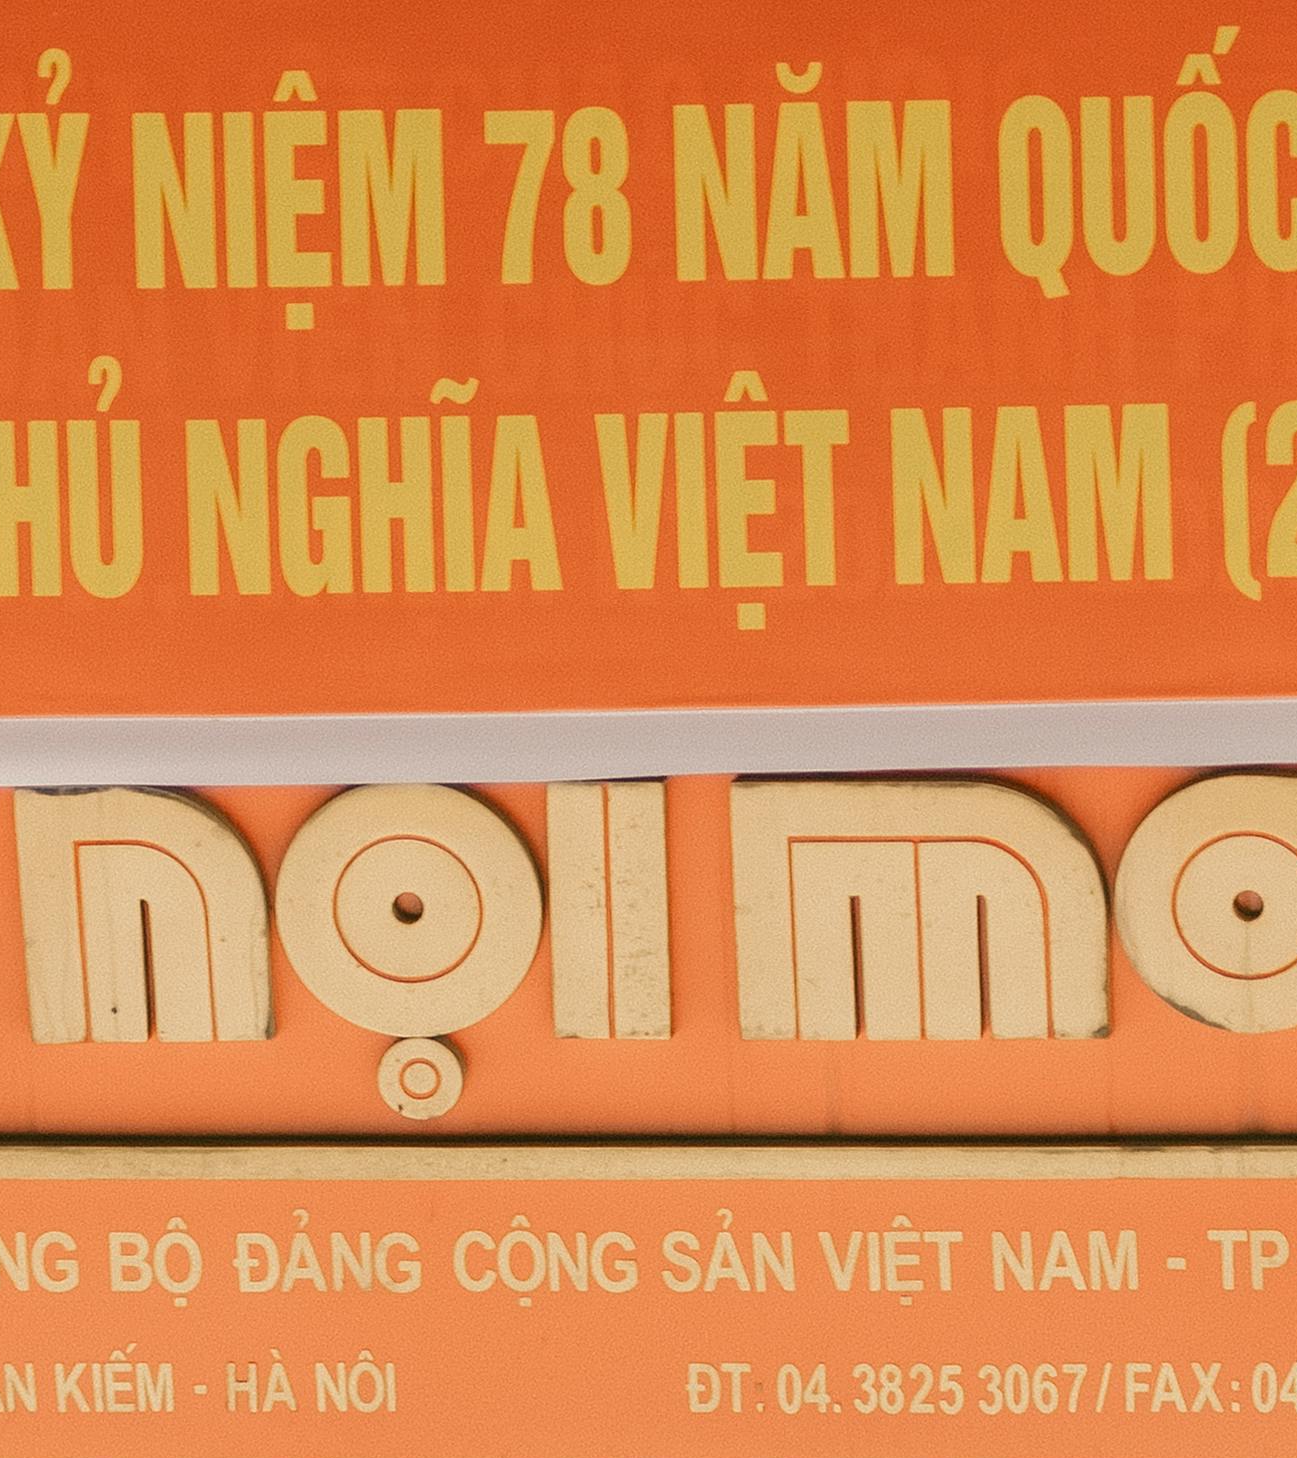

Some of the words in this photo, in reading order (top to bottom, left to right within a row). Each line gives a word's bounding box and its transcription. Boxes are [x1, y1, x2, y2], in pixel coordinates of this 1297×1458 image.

[132, 70, 446, 331] NIỆM
[484, 106, 631, 286] 78
[673, 62, 954, 282] NĂM
[185, 378, 563, 598] NGHĨA
[595, 370, 849, 631] VIỆT
[891, 402, 1173, 586] NAM
[107, 1216, 204, 1309] BỘ
[232, 1208, 423, 1295] ĐẢNG
[452, 1214, 639, 1308] CỘNG
[661, 1207, 797, 1294] SẢN
[818, 1214, 965, 1307] VIỆT
[990, 1229, 1140, 1293] NAM
[1206, 1228, 1291, 1292] TP
[53, 1343, 176, 1414] KIẾM
[225, 1347, 298, 1413] HÀ
[685, 1361, 767, 1414] ĐT:
[851, 1362, 966, 1416] 3825
[1123, 1361, 1243, 1414] FAX:
